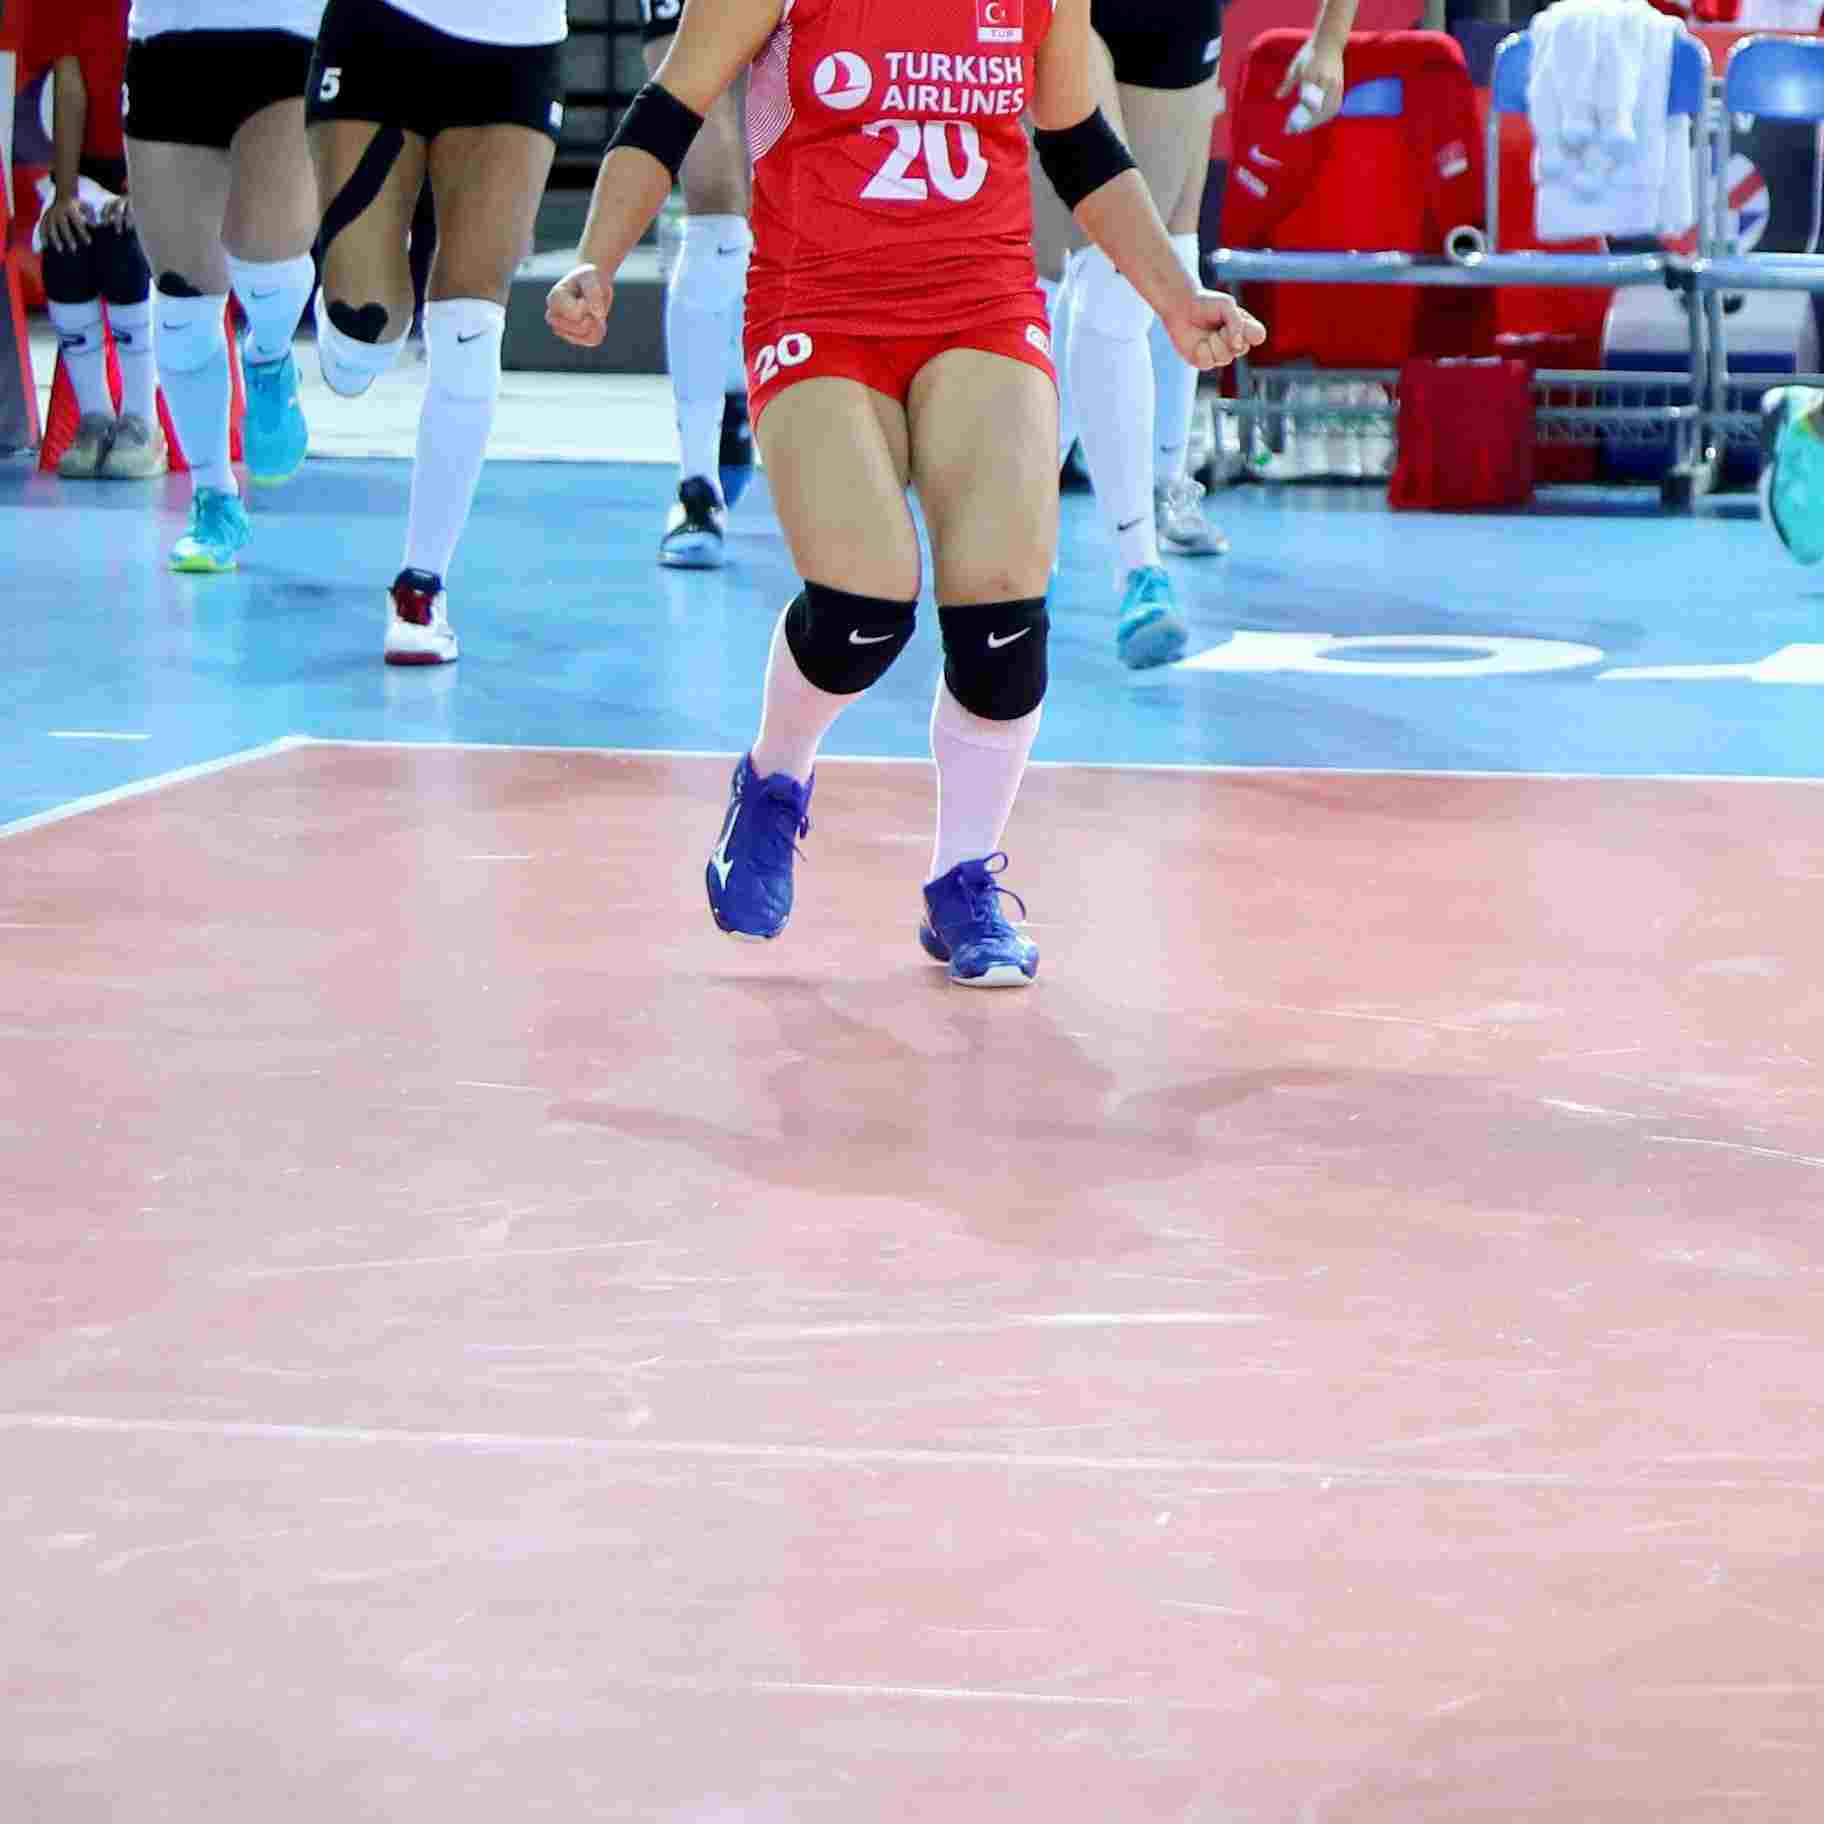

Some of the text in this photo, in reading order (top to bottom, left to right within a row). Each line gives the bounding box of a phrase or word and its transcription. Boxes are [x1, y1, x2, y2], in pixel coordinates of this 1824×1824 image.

[319, 67, 342, 101] 5
[884, 52, 1024, 85] TURKISH
[880, 85, 1024, 116] AIRLINES
[860, 119, 990, 203] 20
[752, 332, 813, 384] 20
